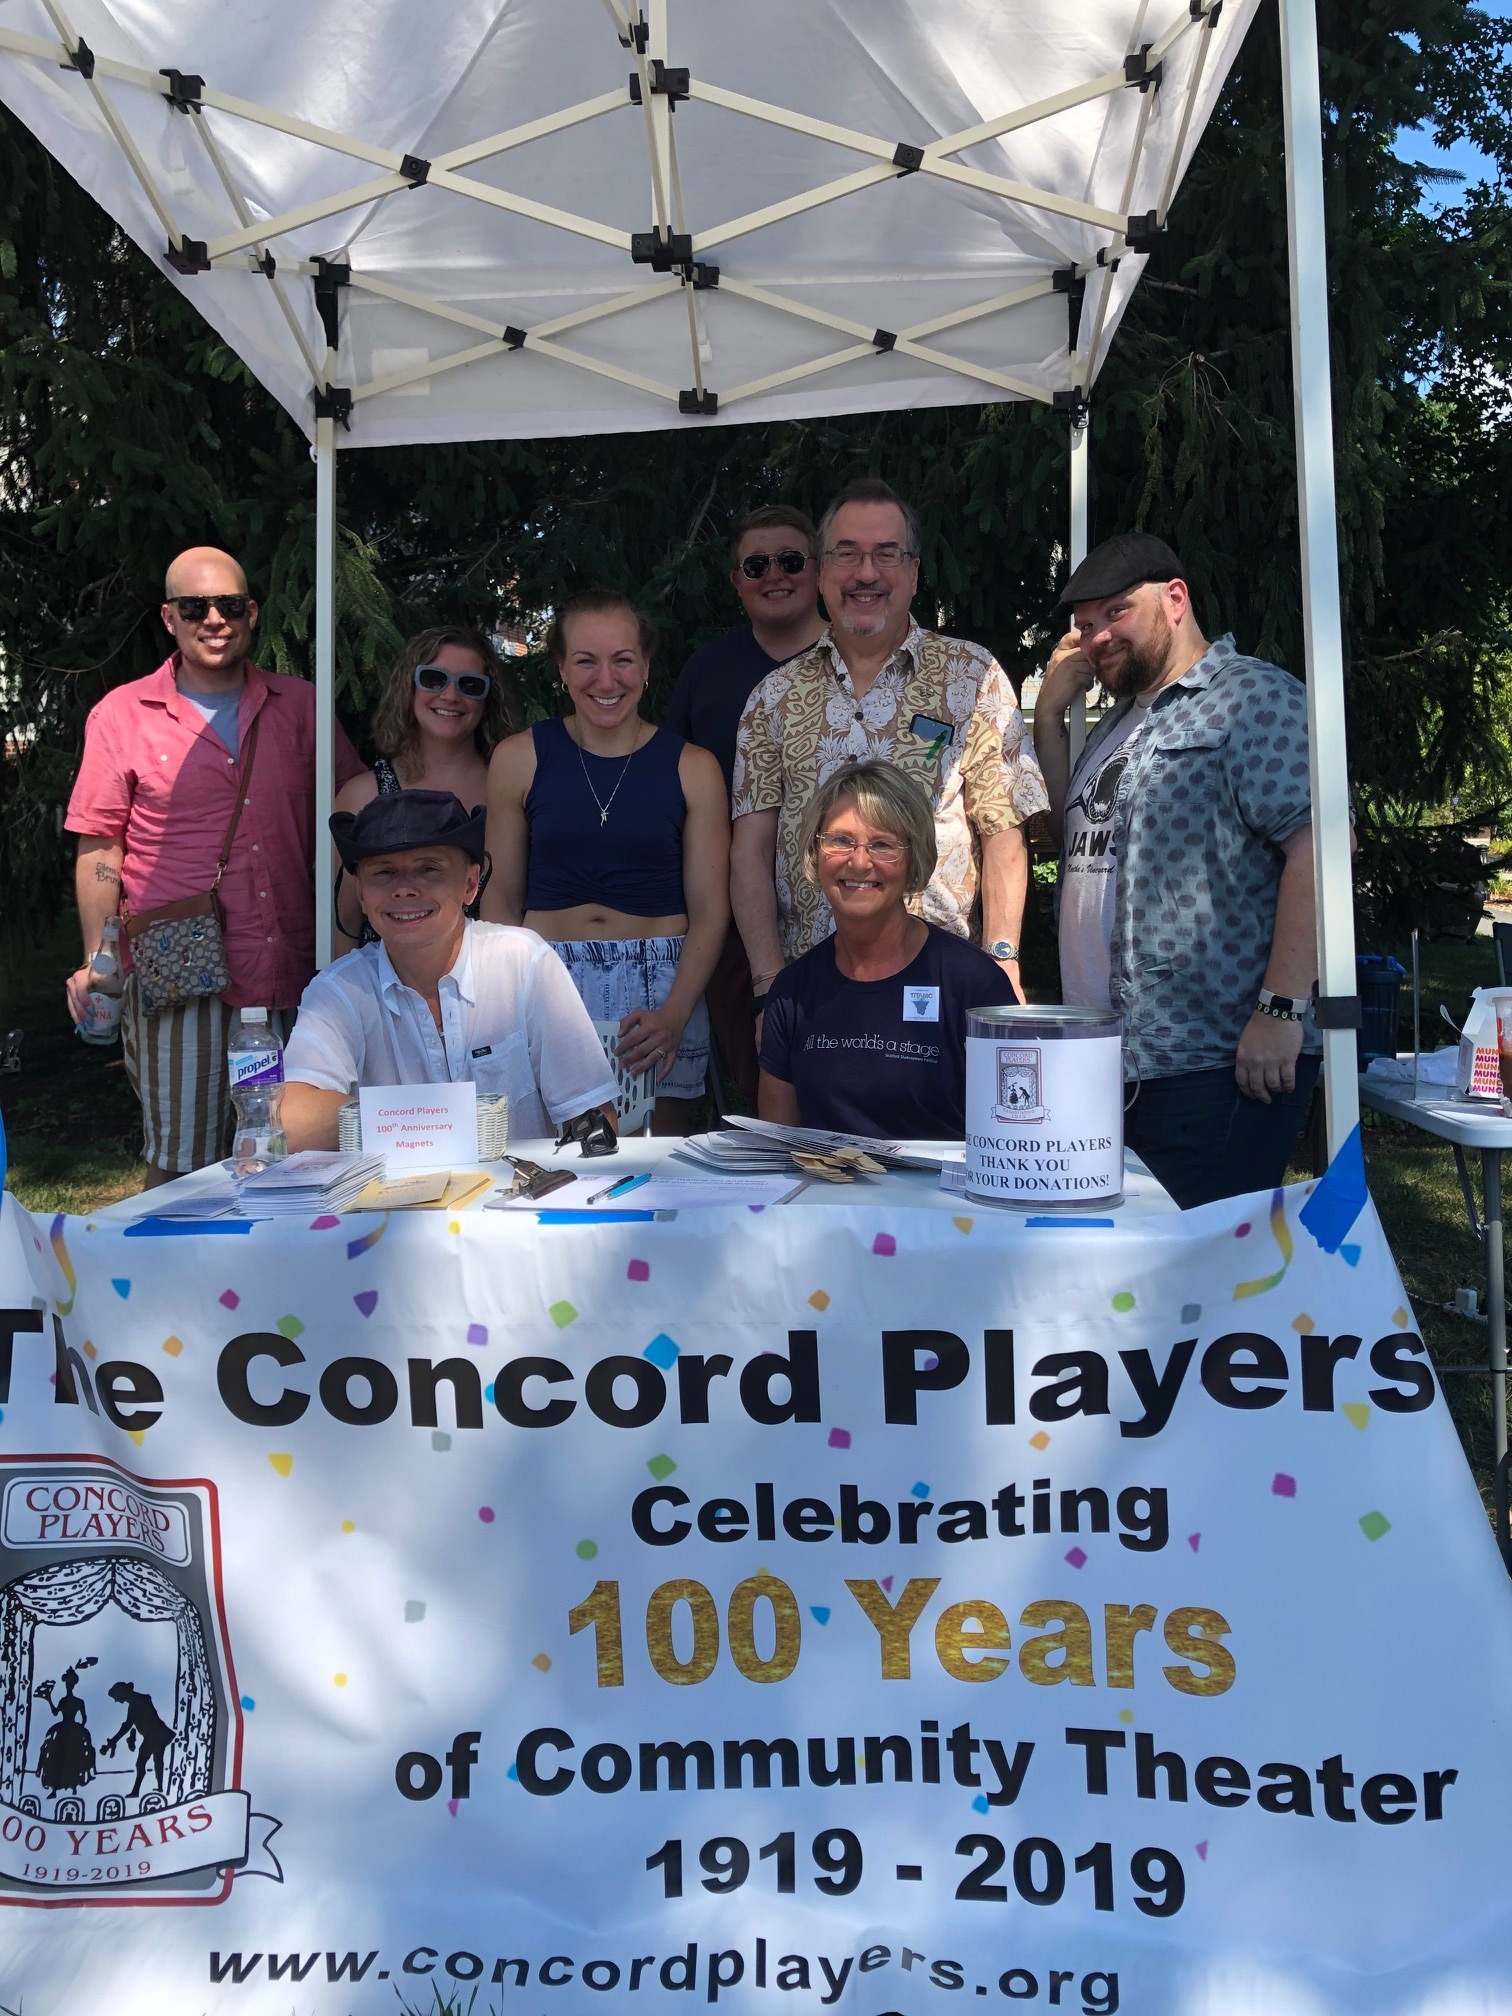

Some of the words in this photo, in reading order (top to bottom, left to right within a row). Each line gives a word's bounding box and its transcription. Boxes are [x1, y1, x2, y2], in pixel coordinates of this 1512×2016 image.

[803, 1034, 815, 1051] All
[816, 1033, 839, 1049] the
[840, 1033, 884, 1050] world's
[886, 1040, 897, 1051] a
[899, 1039, 940, 1058] stage
[1476, 1047, 1498, 1055] MUN
[237, 1054, 270, 1080] propel
[1475, 1055, 1498, 1063] MUN
[1473, 1070, 1502, 1079] MUNC
[1473, 1077, 1503, 1087] MUNC
[1473, 1085, 1502, 1094] MUNC
[378, 1107, 415, 1117] Concord
[417, 1106, 449, 1116] Players
[400, 1123, 453, 1132] Anniversary
[395, 1140, 434, 1150] Magnets
[973, 1135, 1040, 1152] CONCORD
[1045, 1136, 1112, 1153] PLAYERS
[980, 1154, 1029, 1171] THANK
[1034, 1158, 1071, 1172] YOU
[975, 1172, 1010, 1189] YOUR
[1014, 1174, 1110, 1190] DONATIONS!
[216, 1330, 821, 1429] Concord
[881, 1329, 1436, 1438] Players
[26, 1486, 170, 1532] CONCORD
[632, 1479, 1169, 1552] Celebrating
[37, 1513, 165, 1552] PLAYERS
[568, 1577, 800, 1688] 100
[844, 1577, 1236, 1697] Years
[396, 1731, 481, 1802] of
[515, 1720, 1035, 1807] Community
[1065, 1727, 1458, 1825] Theater
[0, 1814, 46, 1852] 00
[66, 1803, 213, 1856] YEARS
[22, 1861, 151, 1882] 1919-2019
[645, 1828, 863, 1898] 1919
[955, 1833, 1185, 1918] 2019
[210, 1938, 1119, 2016] www.concordplayers.org
